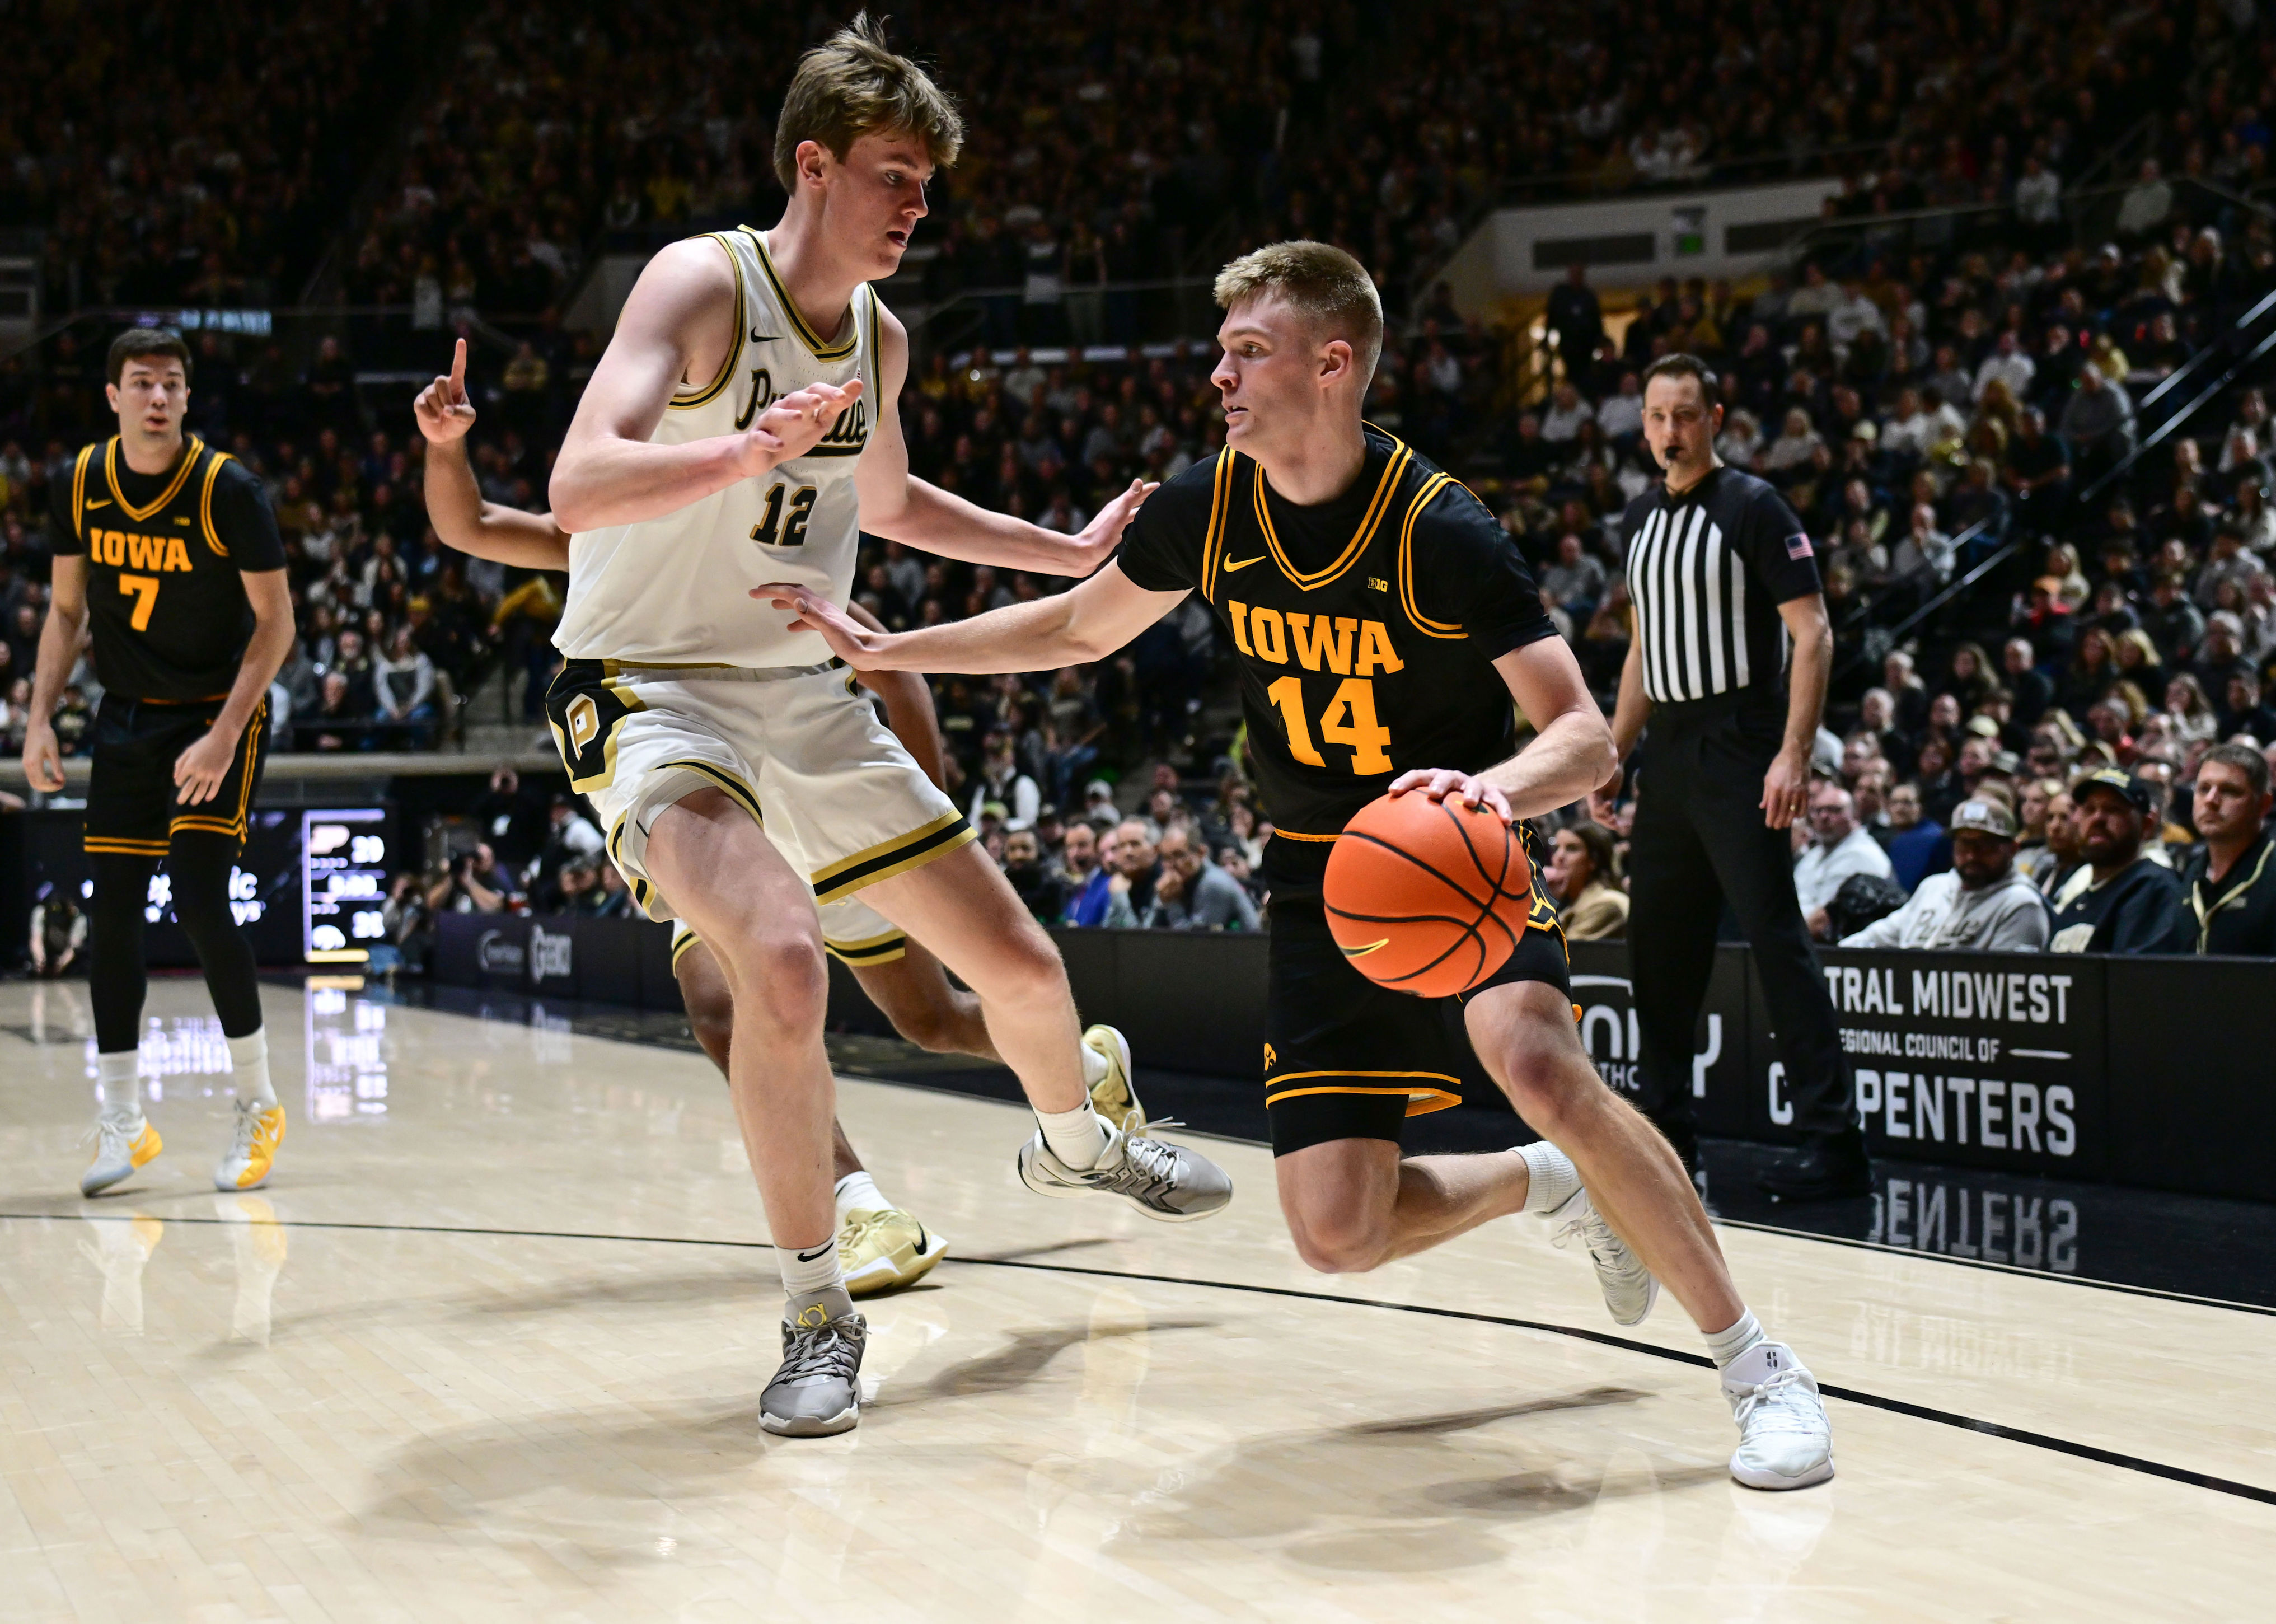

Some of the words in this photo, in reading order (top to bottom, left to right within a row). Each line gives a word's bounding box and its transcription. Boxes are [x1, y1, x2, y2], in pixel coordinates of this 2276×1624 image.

[750, 482, 817, 546] 12
[90, 528, 193, 572] IOWA
[119, 573, 160, 632] 7
[1228, 600, 1404, 676] IOWA
[1267, 676, 1394, 776] 14
[1823, 966, 1903, 1015] TRAL
[1912, 970, 2073, 1024] MIDWEST
[1905, 1032, 1974, 1061] COUNCIL
[1978, 1038, 2001, 1063] OF
[1768, 1061, 2076, 1157] CPENTERS
